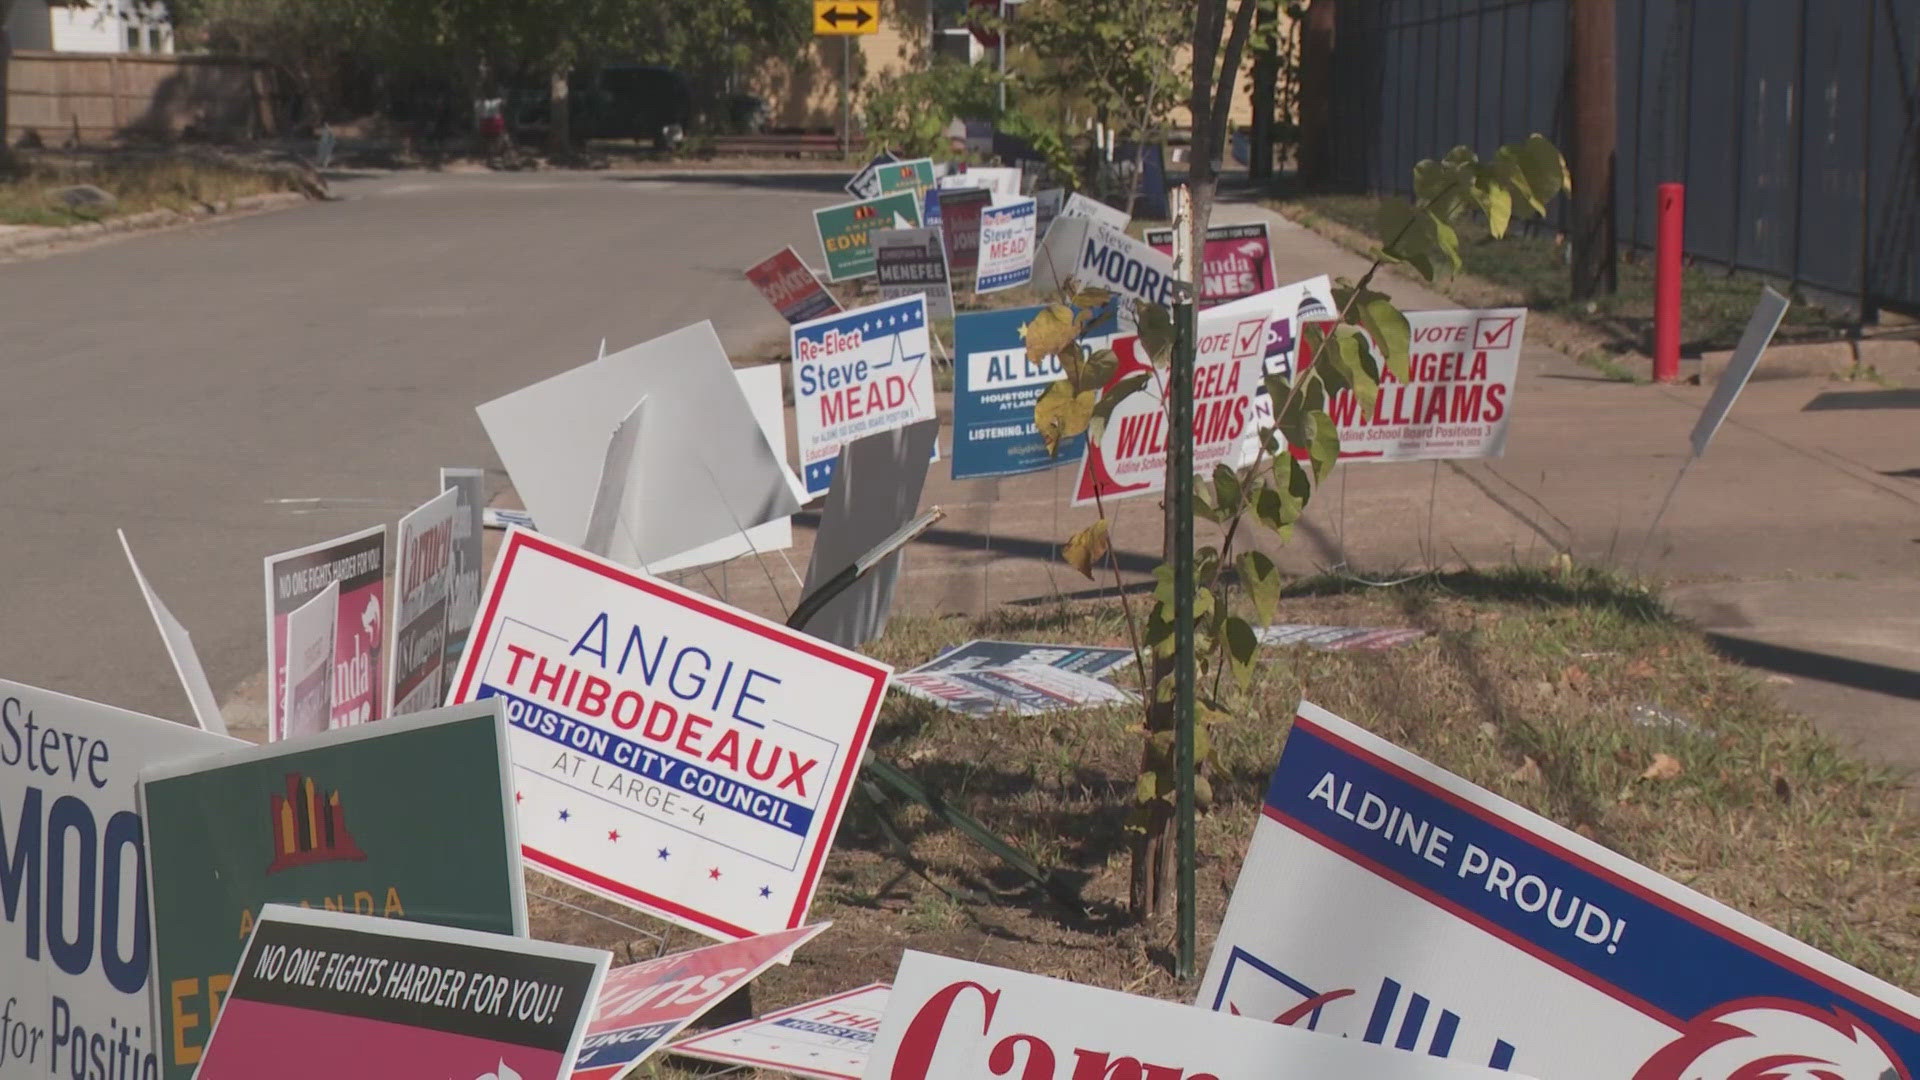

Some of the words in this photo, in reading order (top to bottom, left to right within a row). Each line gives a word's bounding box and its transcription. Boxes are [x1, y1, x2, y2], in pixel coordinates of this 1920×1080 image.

[983, 227, 1012, 244] Steve
[990, 239, 1026, 260] MEAD
[1099, 226, 1132, 254] Steve
[880, 262, 944, 282] MENEFEE
[1083, 238, 1173, 311] MOORE
[1201, 273, 1255, 296] NES
[799, 331, 861, 363] Re-Elect
[1414, 327, 1468, 343] VOTE
[800, 360, 868, 397] Steve
[987, 354, 1017, 383] AL
[820, 375, 906, 427] MEAD
[981, 389, 1033, 405] HOUSTON
[1115, 395, 1249, 461] WILAMS
[1366, 426, 1401, 441] School
[1402, 426, 1433, 439] Board
[1435, 424, 1482, 438] Positions
[569, 611, 782, 730] ANGIE
[1, 697, 109, 788] Steve
[506, 643, 818, 798] THIBODEAUX
[494, 692, 610, 756] OUSTON
[613, 743, 676, 784] CITY
[679, 765, 793, 828] COUNCIL
[552, 750, 586, 778] AT
[592, 767, 707, 826] LARGE-4
[1308, 770, 1455, 868] ALDINE
[1457, 843, 1628, 956] PROUD!
[0, 786, 152, 994] MOO
[253, 944, 284, 983] NO
[284, 948, 326, 988] ONE
[320, 954, 388, 997] FIGHTS
[383, 963, 466, 1010] HARDER
[466, 973, 509, 1017] FOR
[506, 981, 564, 1026] YOU!
[0, 996, 44, 1067] for
